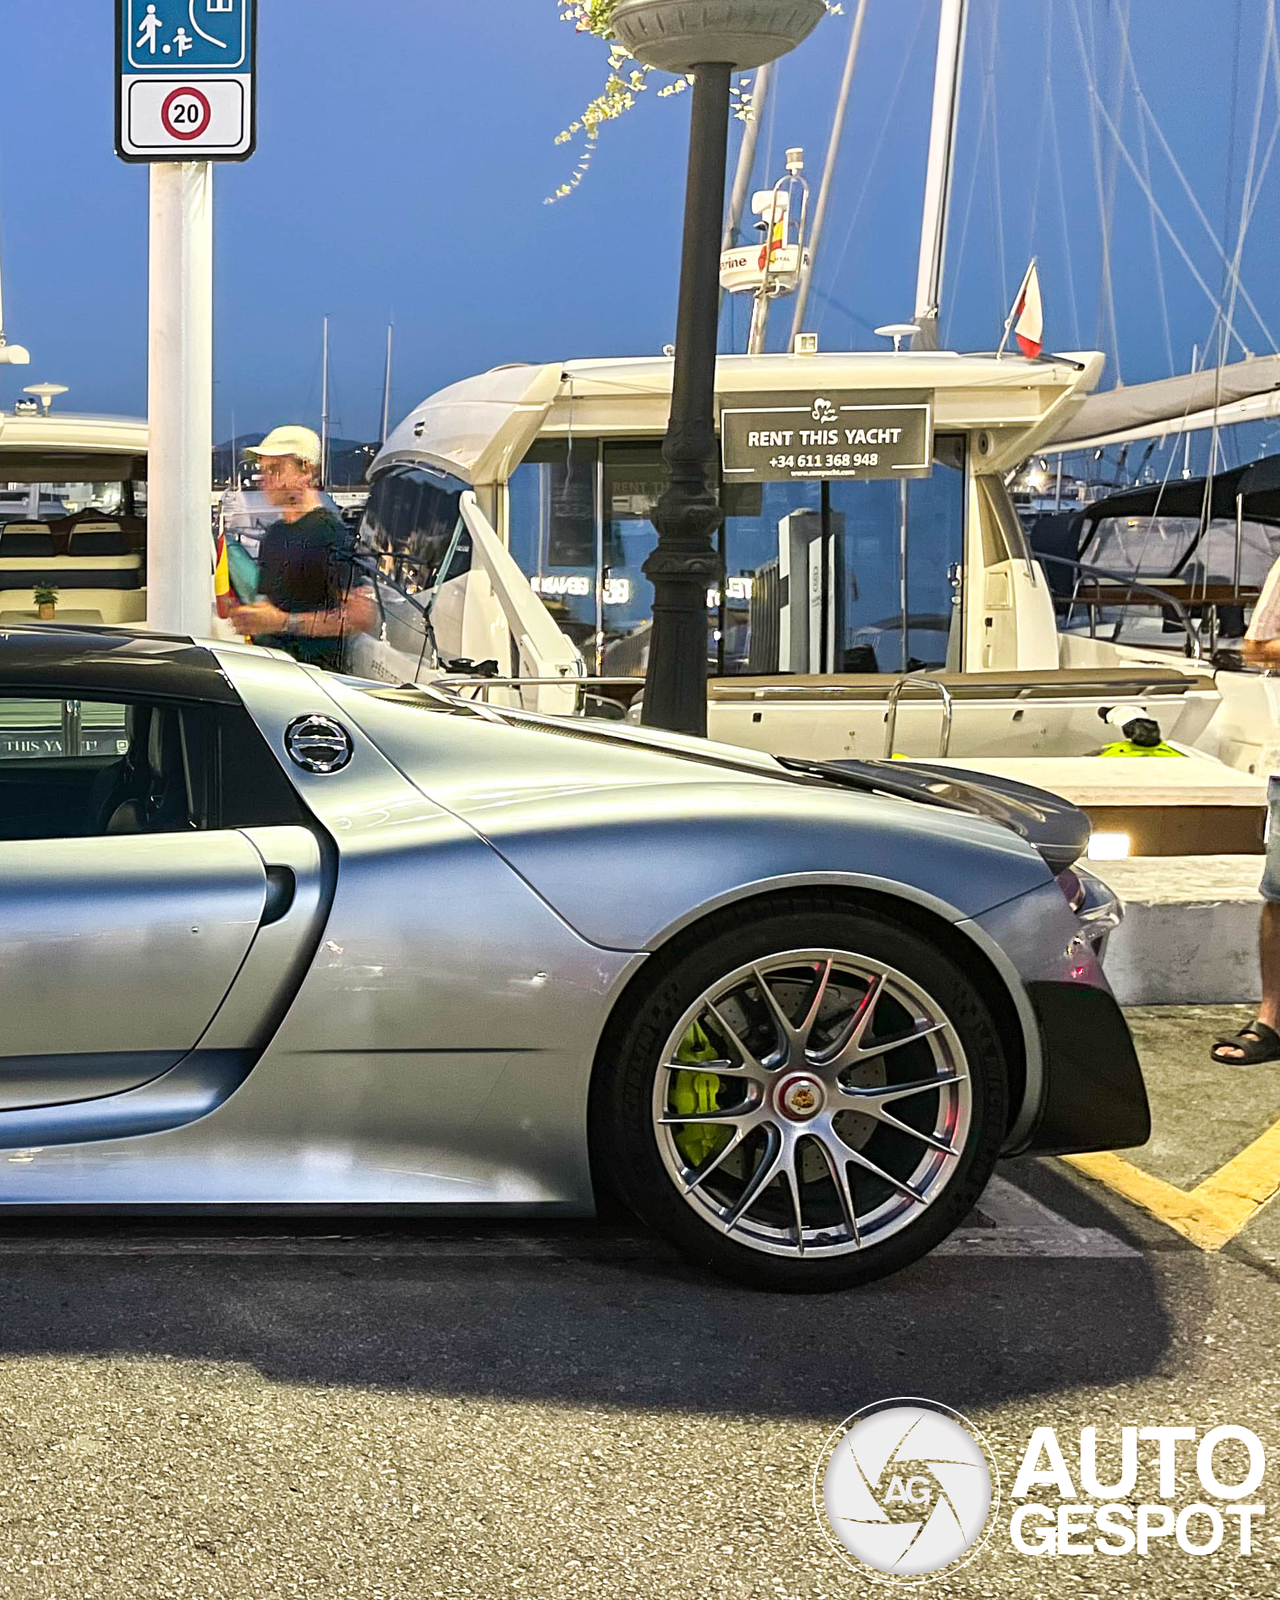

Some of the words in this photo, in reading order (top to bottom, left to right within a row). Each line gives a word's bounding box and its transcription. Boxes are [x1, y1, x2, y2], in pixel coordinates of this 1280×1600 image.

[173, 104, 199, 123] 20
[748, 431, 793, 447] RENT
[799, 430, 838, 446] THIS
[844, 428, 902, 445] YACHT
[769, 455, 794, 468] +34
[797, 454, 822, 467] 611
[825, 453, 850, 467] 368
[853, 453, 878, 466] 948
[6, 741, 40, 752] THIS
